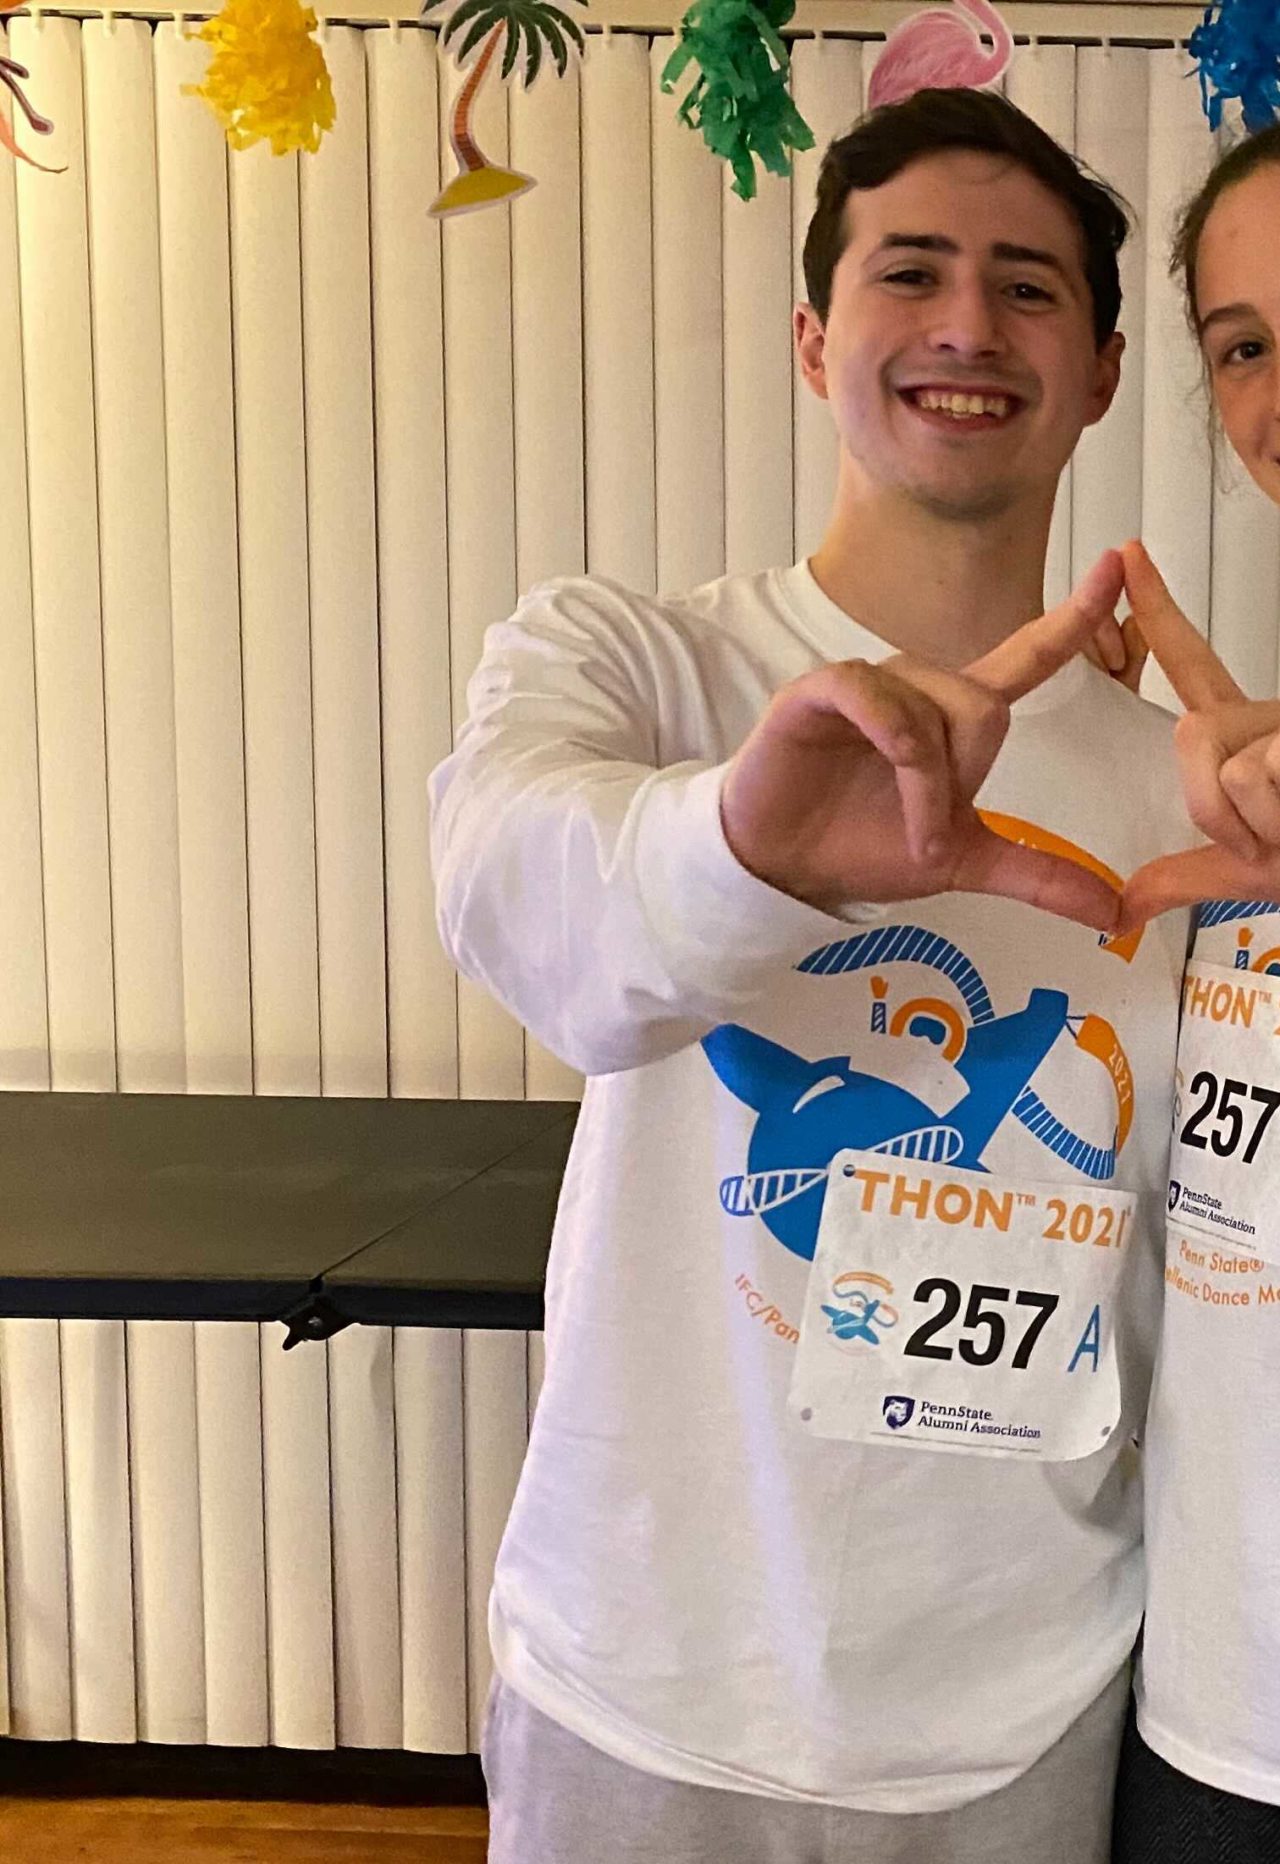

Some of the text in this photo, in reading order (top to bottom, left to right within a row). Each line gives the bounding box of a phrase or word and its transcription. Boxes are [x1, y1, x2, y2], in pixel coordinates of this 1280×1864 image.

[1108, 1043, 1132, 1105] 2021
[1182, 1186, 1223, 1210] PennState
[1042, 1198, 1126, 1248] 2021
[1179, 1200, 1207, 1219] Alumni
[1207, 1210, 1256, 1236] Association
[1179, 1239, 1206, 1267] Penn
[1202, 1282, 1251, 1306] Dance
[904, 1276, 1101, 1373] 257 A
[920, 1400, 993, 1420] PennState
[917, 1415, 1042, 1439] Alumni Association
